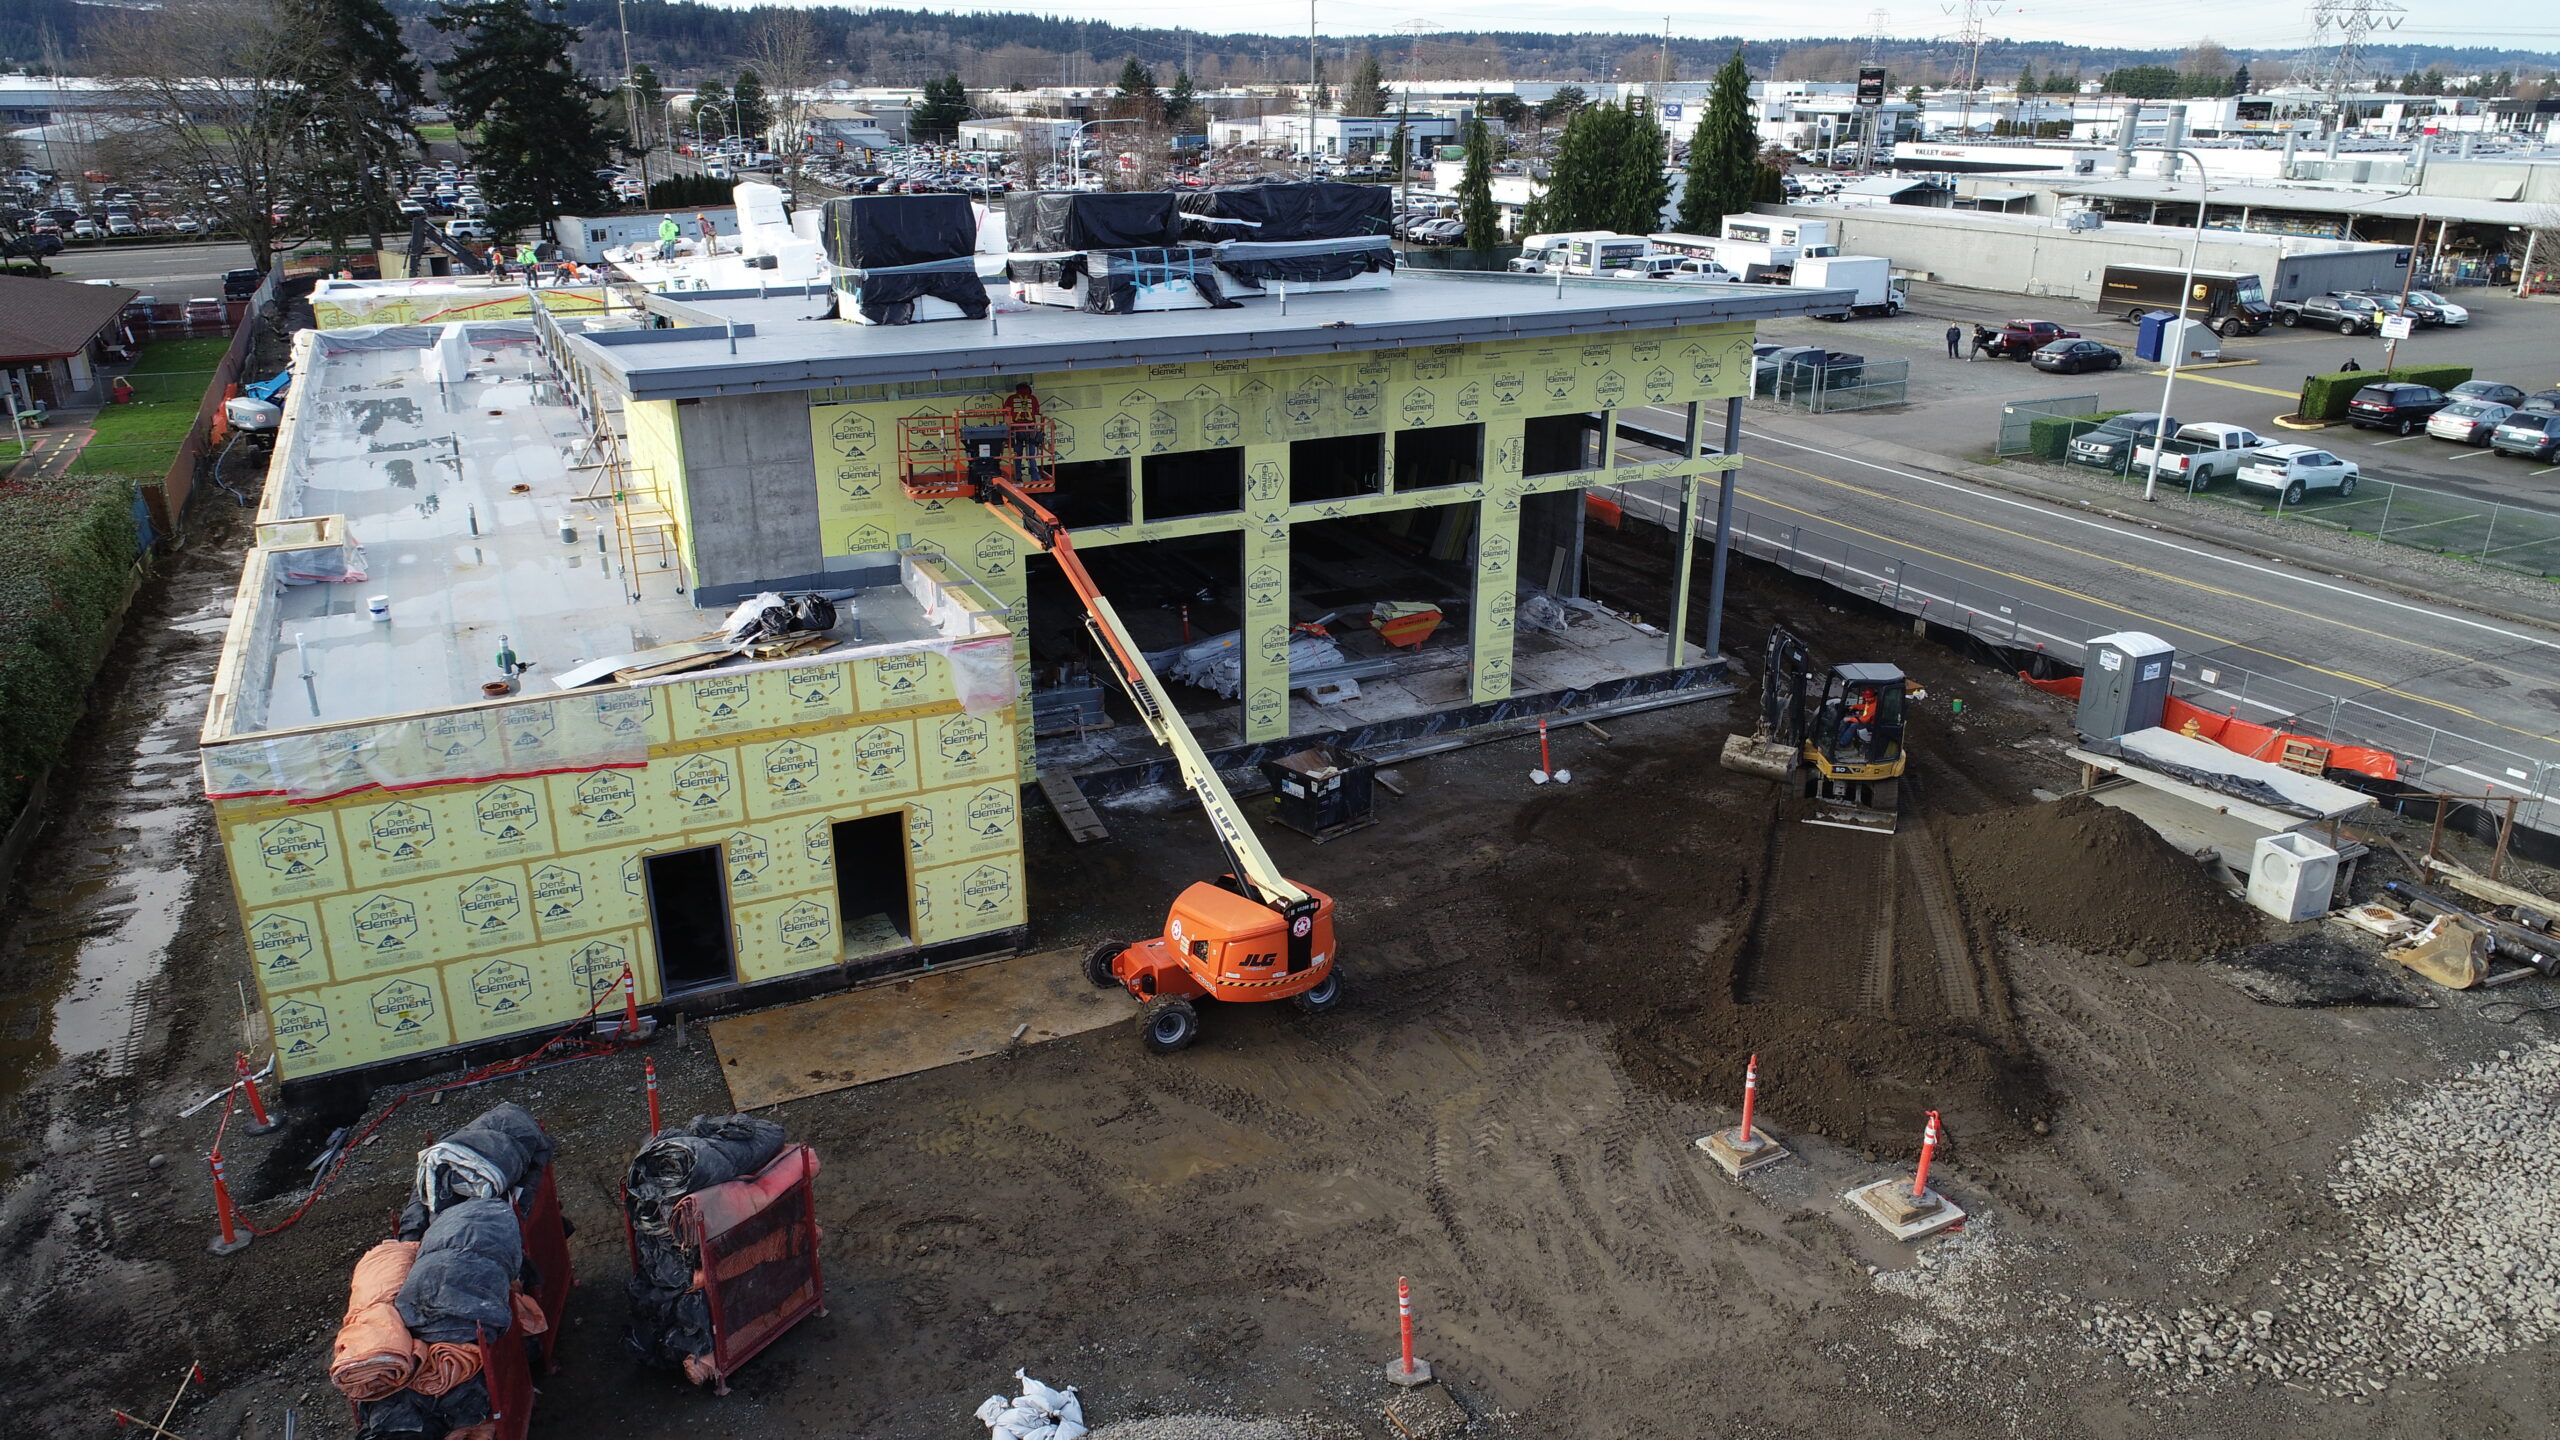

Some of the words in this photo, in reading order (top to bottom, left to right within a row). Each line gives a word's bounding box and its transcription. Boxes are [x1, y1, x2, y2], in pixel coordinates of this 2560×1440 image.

[1915, 148, 1939, 156] VALLEY
[1584, 349, 1610, 357] Element
[1634, 345, 1660, 353] Element
[1701, 356, 1715, 364] Dens
[1151, 366, 1185, 376] Element
[1215, 363, 1248, 372] Element
[1360, 367, 1390, 375] Element
[1417, 362, 1446, 370] Element
[1696, 362, 1720, 370] Element
[1554, 369, 1568, 377] Dens
[1495, 380, 1522, 388] Element
[1548, 375, 1574, 383] Element
[1597, 386, 1623, 394] Element
[1647, 381, 1673, 390] Element
[1294, 391, 1311, 399] Dens
[974, 402, 993, 410] Dens
[1288, 397, 1318, 406] Element
[1411, 398, 1426, 406] Dens
[1404, 404, 1433, 412] Element
[917, 419, 937, 427] Dens
[1206, 422, 1239, 431] Element
[843, 425, 863, 433] Dens
[835, 430, 874, 441] Element
[1105, 430, 1139, 440] Element
[849, 449, 861, 457] GP
[848, 464, 869, 473] Dens
[841, 470, 878, 480] Element
[1617, 474, 1642, 482] Element
[854, 488, 866, 497] GP
[929, 503, 940, 511] GP
[858, 537, 878, 545] Dens
[851, 542, 889, 552] Element
[986, 544, 1004, 552] Dens
[979, 549, 1013, 559] Element
[1483, 549, 1508, 558] Element
[1250, 580, 1280, 590] Element
[1270, 634, 1286, 643] Dens
[890, 653, 912, 663] Dens
[802, 665, 825, 675] Dens
[880, 658, 925, 672] Element
[791, 671, 838, 684] Element
[708, 678, 733, 688] Dens
[896, 681, 911, 690] GP
[699, 684, 746, 698] Element
[809, 693, 824, 703] GP
[602, 699, 648, 712] Element
[1250, 702, 1280, 712] Element
[716, 706, 731, 716] GP
[621, 721, 636, 731] GP
[952, 728, 974, 736] Dens
[943, 732, 987, 745] Element
[859, 745, 902, 759] Element
[779, 756, 803, 765] Dens
[770, 760, 817, 773] Element
[689, 770, 714, 779] Dens
[679, 775, 727, 788] Element
[787, 781, 801, 790] GP
[593, 784, 618, 794] Dens
[582, 789, 631, 804] Element
[695, 796, 709, 806] GP
[492, 801, 519, 811] Dens
[981, 801, 1001, 810] Dens
[1194, 777, 1216, 803] JLG
[1215, 807, 1240, 840] LIFT
[482, 806, 533, 820] Element
[602, 812, 617, 823] GP
[972, 806, 1013, 819] Element
[387, 817, 415, 828] Dens
[376, 824, 432, 838] Element
[502, 829, 518, 839] GP
[986, 827, 998, 835] GP
[267, 841, 323, 855] Element
[730, 846, 753, 855] Dens
[290, 864, 305, 874] GP
[737, 872, 751, 881] GP
[540, 881, 566, 891] Dens
[976, 878, 996, 887] Dens
[967, 882, 1007, 895] Element
[475, 892, 501, 902] Dens
[465, 896, 516, 911] Element
[370, 911, 398, 921] Dens
[549, 907, 564, 918] GP
[360, 915, 416, 930] Element
[793, 914, 815, 924] Dens
[784, 918, 828, 932] Element
[262, 929, 291, 940] Dens
[253, 934, 306, 950] Element
[381, 938, 397, 948] GP
[800, 940, 813, 948] GP
[275, 957, 291, 968] GP
[1238, 953, 1277, 967] JLG
[576, 960, 624, 975] Element
[488, 974, 514, 985] Dens
[478, 979, 529, 994] Element
[388, 994, 415, 1005] Dens
[378, 999, 430, 1015] Element
[498, 1001, 512, 1011] GP
[281, 1014, 309, 1026] Dens
[275, 1018, 326, 1036] Element
[292, 1043, 308, 1053] GP
